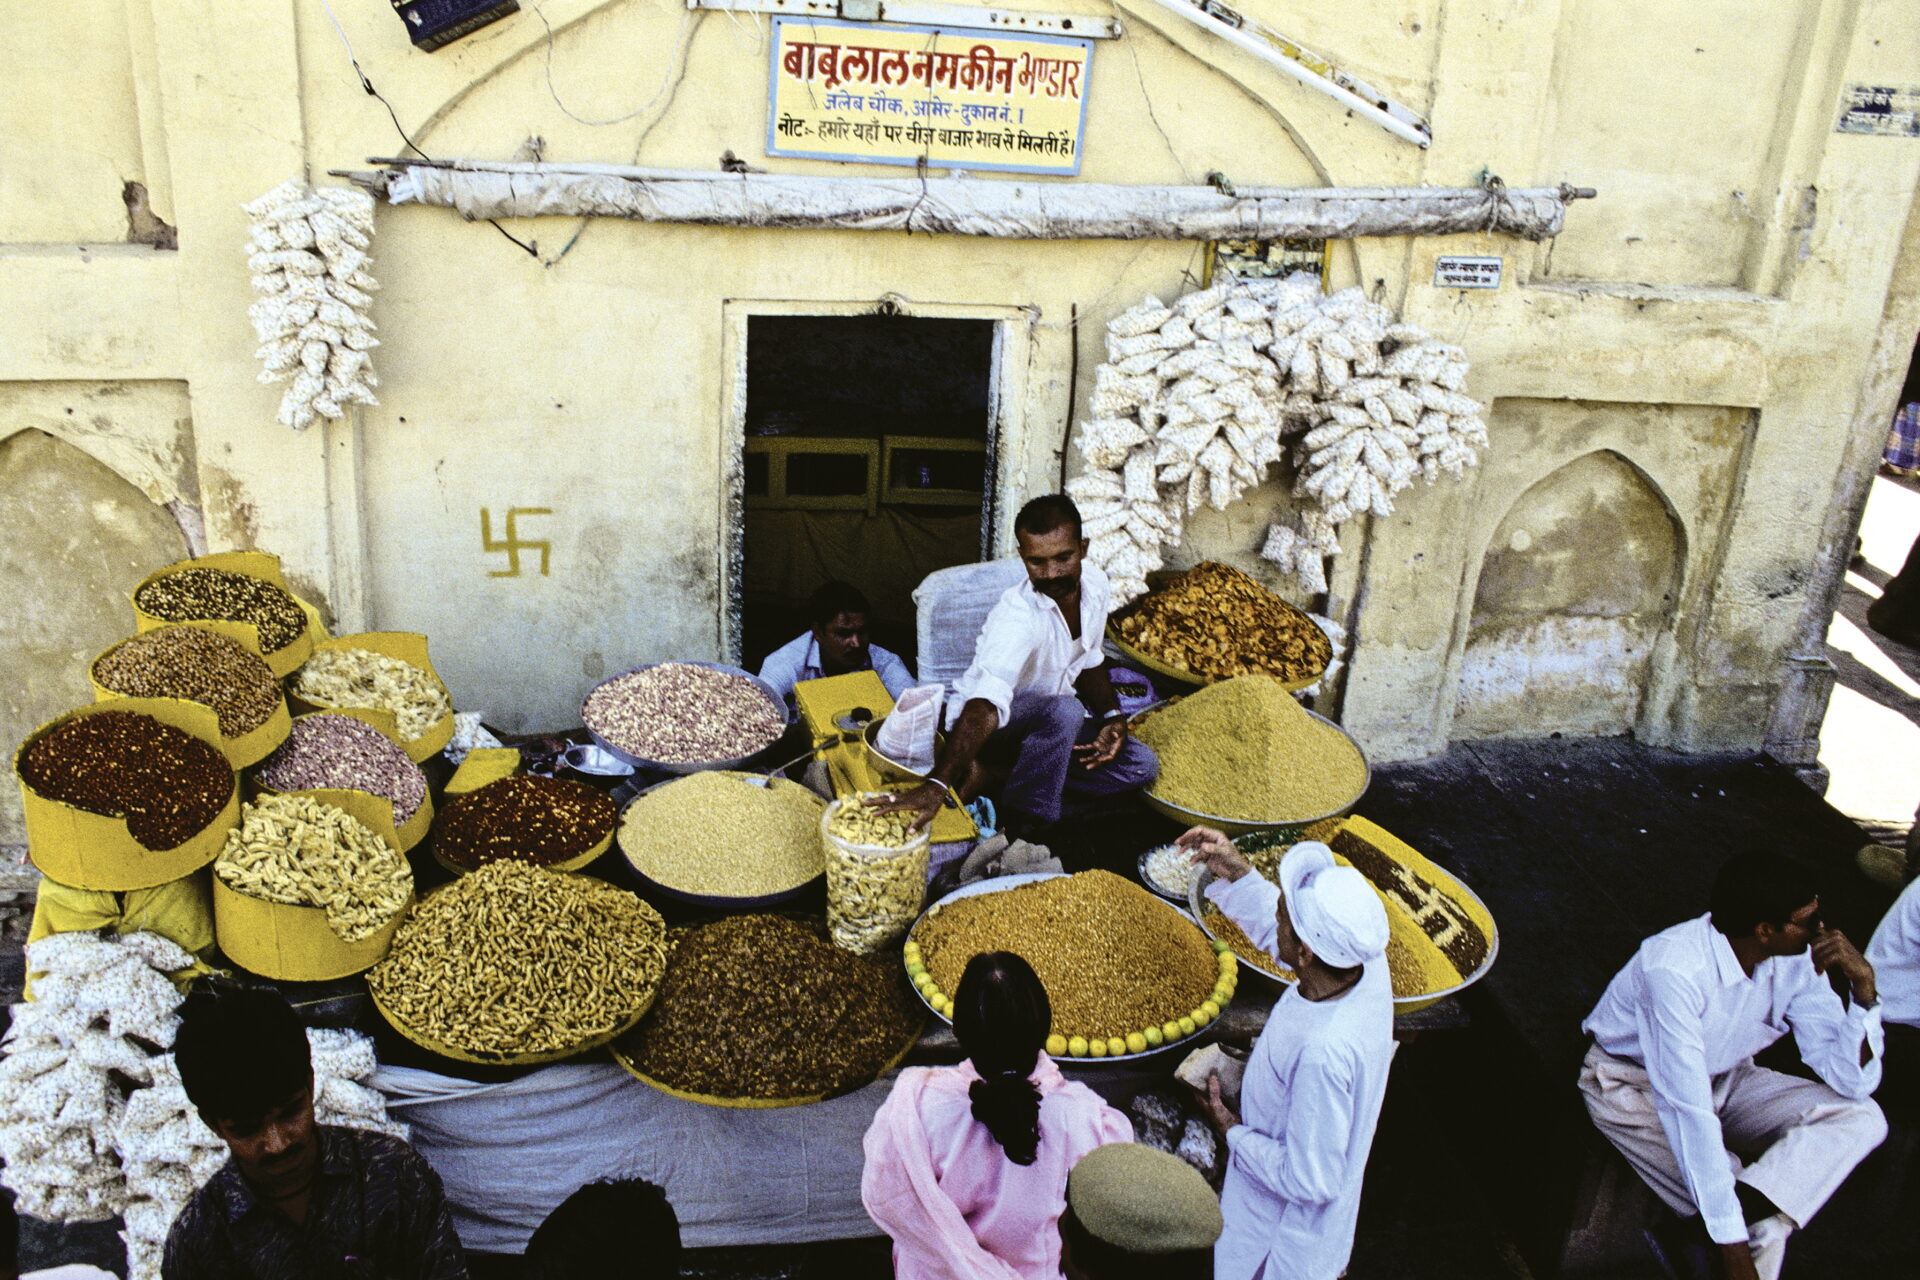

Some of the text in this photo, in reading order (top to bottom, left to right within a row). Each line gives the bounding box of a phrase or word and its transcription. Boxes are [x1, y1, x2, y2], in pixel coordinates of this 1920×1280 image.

[912, 44, 1018, 94] नमकीन
[1018, 51, 1083, 99] भण्डार
[824, 89, 865, 111] जलेब
[868, 89, 908, 117] चौक,
[818, 116, 852, 141] हमारे
[852, 116, 880, 145] यहाँ
[882, 125, 903, 144] पर
[937, 127, 974, 149] बाजार
[975, 129, 1002, 149] भाव
[1002, 127, 1015, 152] से
[1016, 128, 1060, 156] मिलती
